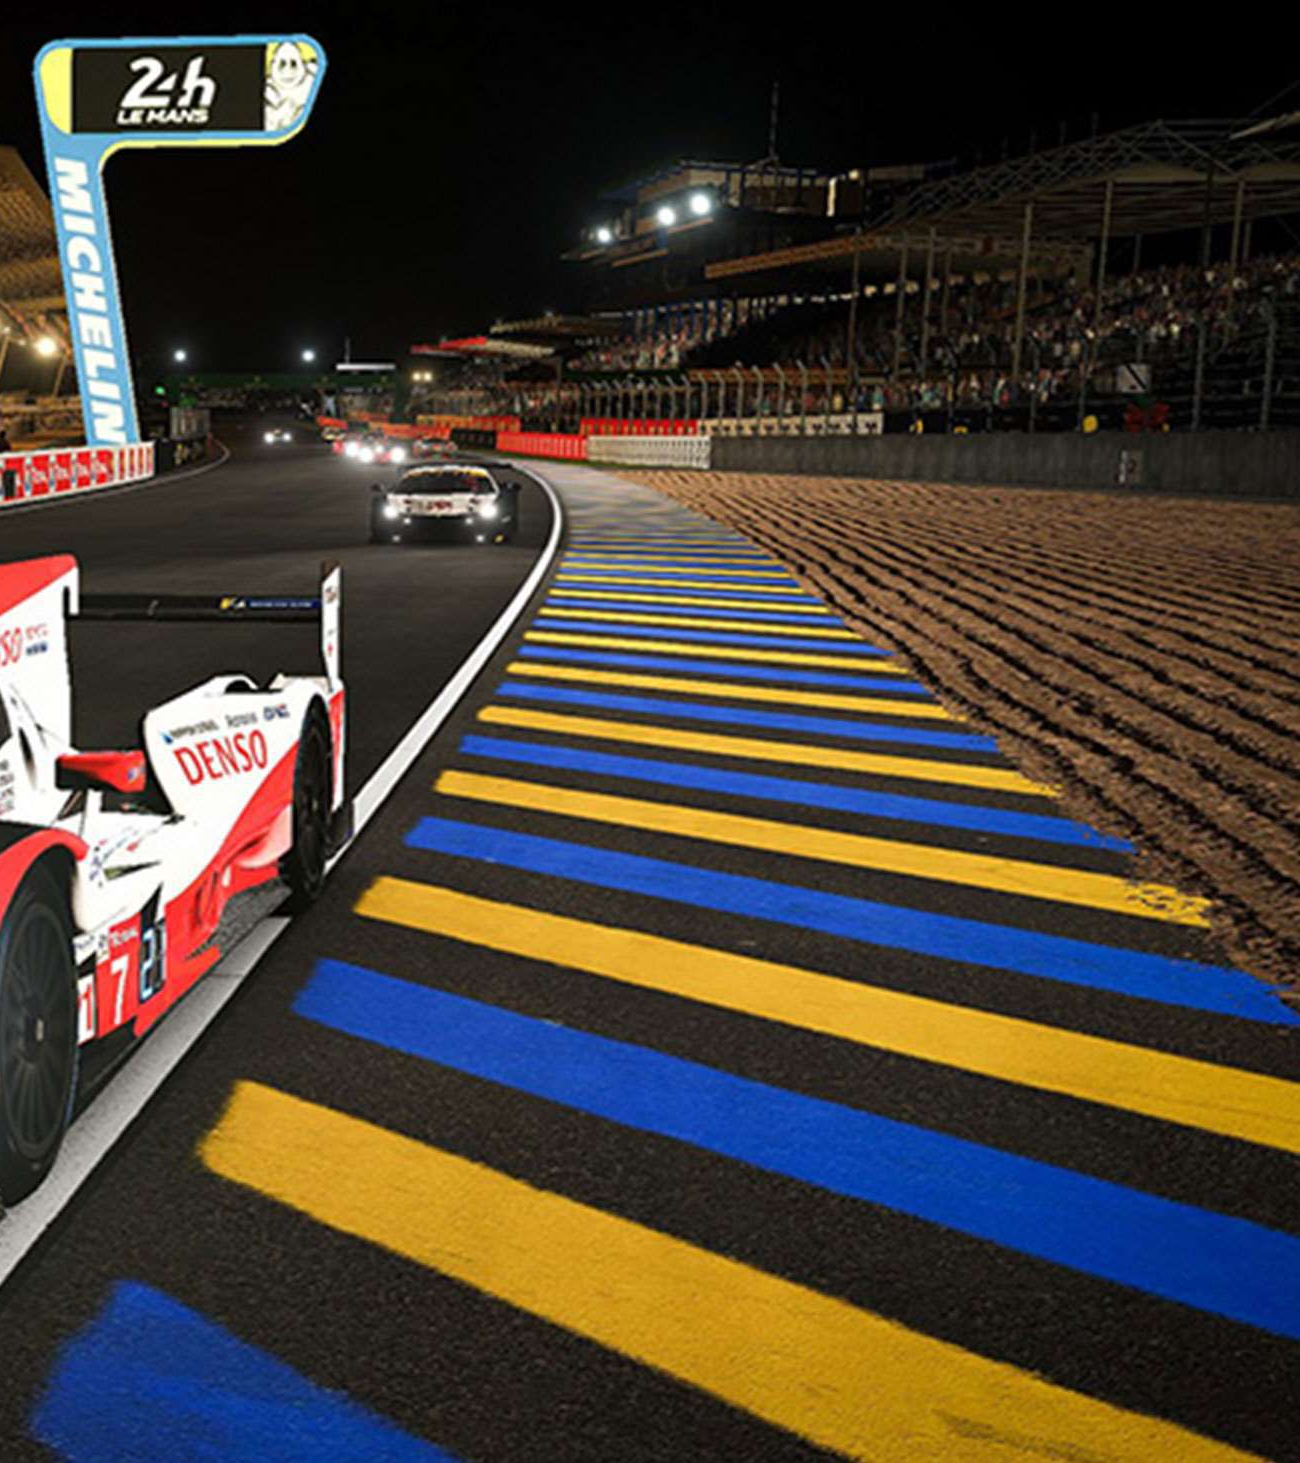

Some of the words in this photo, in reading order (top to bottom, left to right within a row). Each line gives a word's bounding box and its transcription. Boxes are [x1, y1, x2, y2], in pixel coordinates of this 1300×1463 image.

[120, 56, 216, 108] 24h
[117, 110, 143, 125] LE
[146, 109, 209, 124] MANS
[54, 157, 128, 446] MICHELIN
[174, 729, 268, 786] DENSO
[111, 953, 129, 1026] 7
